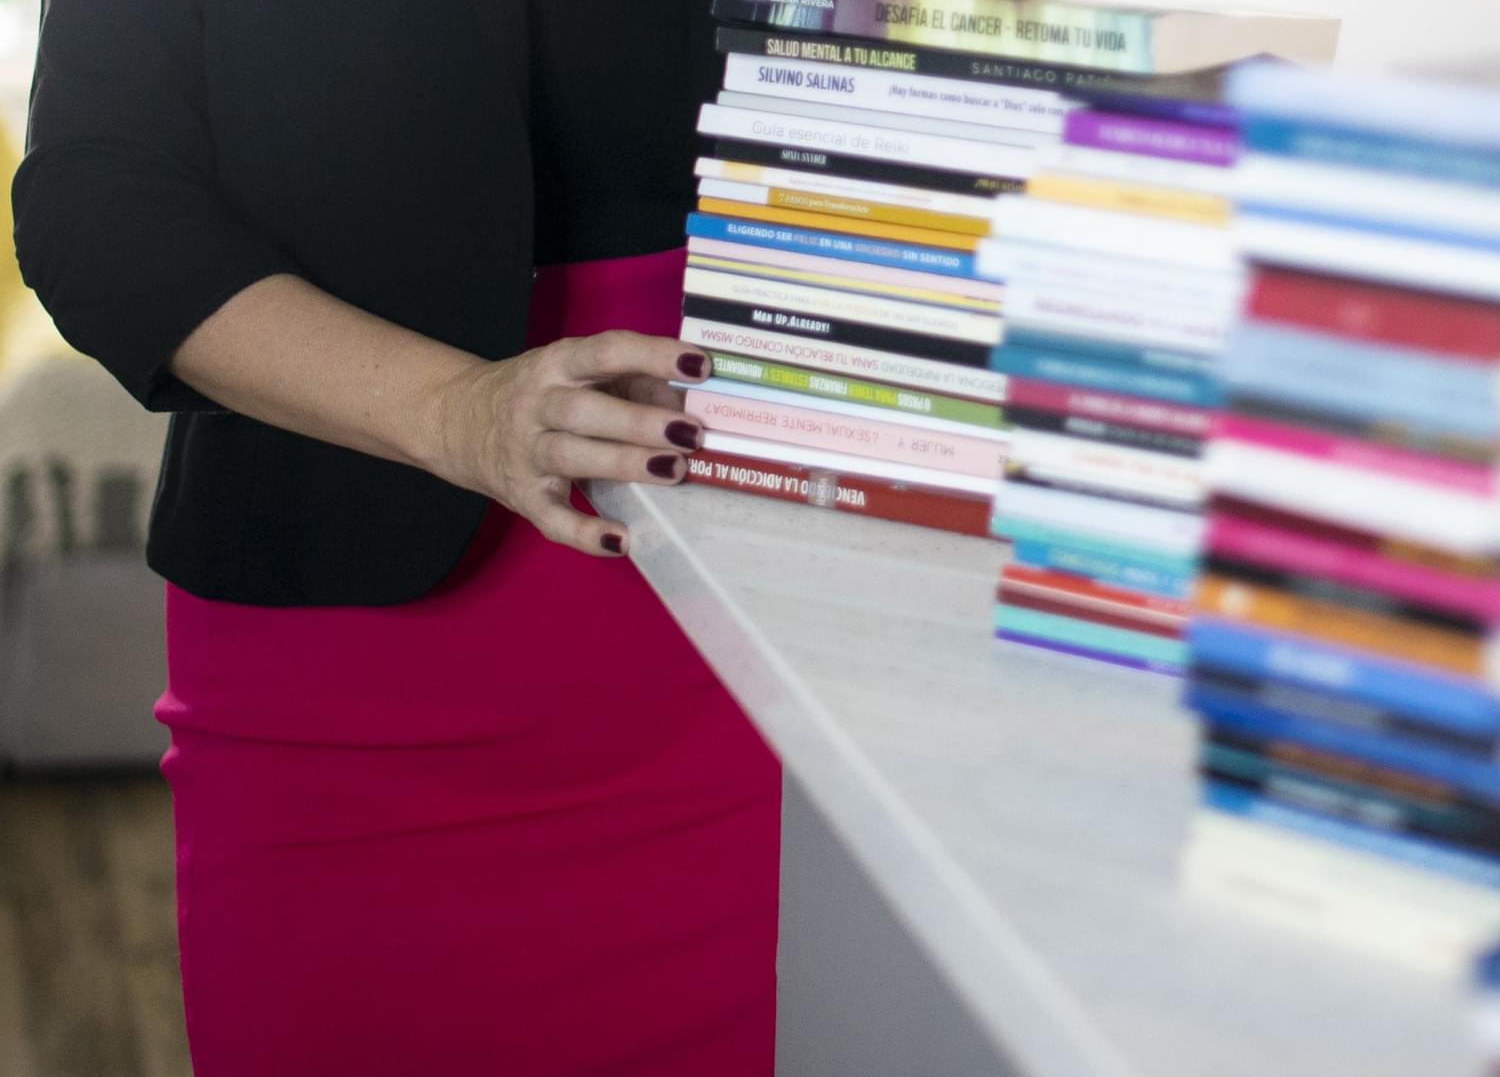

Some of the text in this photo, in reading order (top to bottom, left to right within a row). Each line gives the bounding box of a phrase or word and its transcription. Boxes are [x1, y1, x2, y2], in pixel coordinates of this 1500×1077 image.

[932, 9, 945, 29] EL
[951, 12, 1001, 36] CANCER
[1015, 20, 1070, 45] RETOMA
[1075, 27, 1091, 47] TU
[1094, 29, 1126, 51] VIDA
[767, 38, 916, 71] SALUD MENTAL A TU ALCANCE
[758, 66, 855, 93] SILVINO SALINAS
[971, 62, 1056, 83] SANTIAGO
[788, 126, 846, 146] esencial
[850, 133, 870, 150] de
[874, 136, 910, 156] Reiki
[727, 223, 774, 239] ELIGIENDO
[776, 229, 793, 241] SER
[819, 236, 832, 247] EN
[833, 239, 853, 251] UNA
[902, 249, 918, 260] SIN
[920, 251, 960, 267] SENTIDO
[701, 328, 734, 343] MISMA
[735, 334, 783, 353] CONTIGO
[785, 344, 833, 362] RELACIÓN
[836, 353, 847, 364] TU
[852, 355, 879, 370] SANA
[713, 357, 763, 379] ABUNDANTES
[809, 375, 847, 395] FINANZAS
[898, 393, 923, 410] PASOS
[705, 402, 954, 456] MUJER Y ¿SEXUALMENTE REPRIMIDA?
[688, 457, 712, 476] POR
[715, 462, 729, 480] AL
[730, 465, 783, 490] ADICCIÓN
[784, 475, 798, 492] LA
